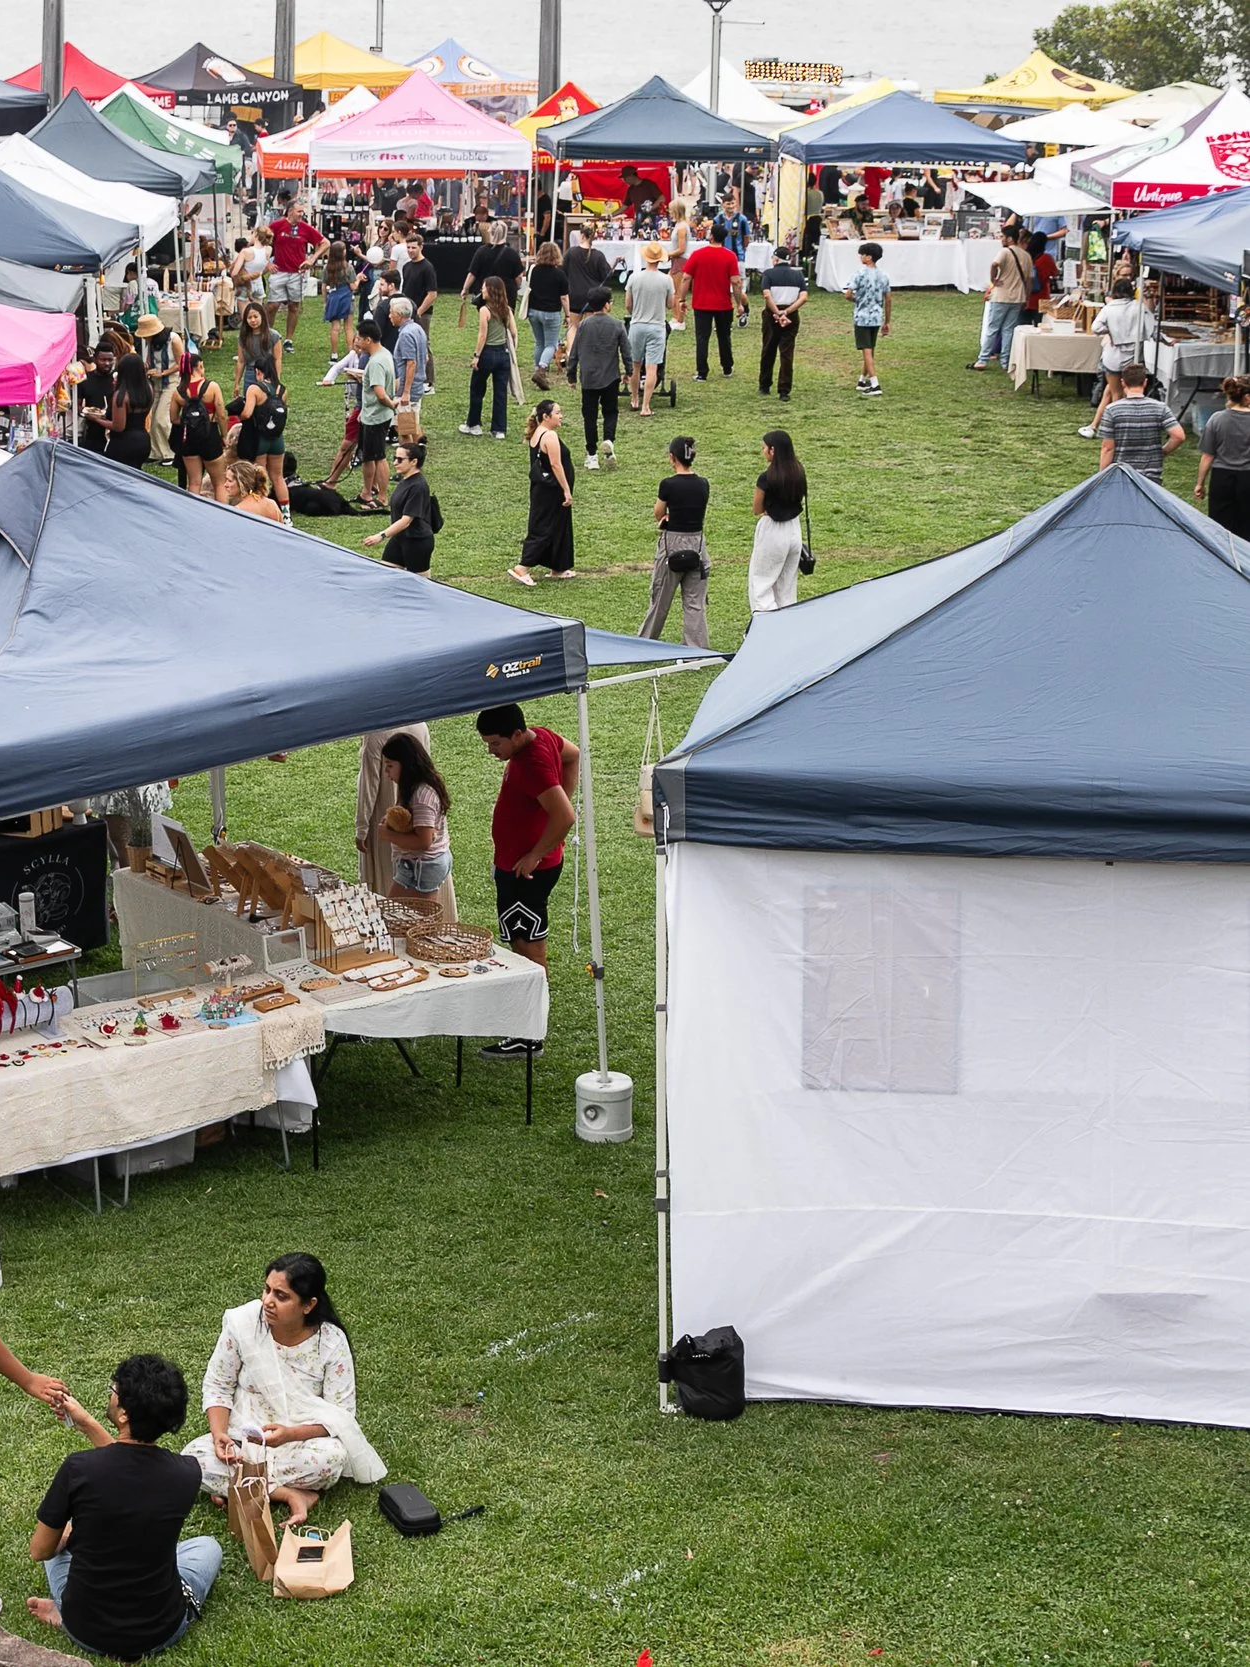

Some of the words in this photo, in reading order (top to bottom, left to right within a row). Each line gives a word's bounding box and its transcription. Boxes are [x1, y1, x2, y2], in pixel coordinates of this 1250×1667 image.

[207, 92, 239, 105] LAMB
[241, 90, 290, 104] CANYON
[350, 151, 377, 162] Life's
[379, 152, 405, 161] flat
[407, 151, 447, 161] without
[449, 150, 488, 162] bubbles
[1133, 185, 1184, 207] Unique
[501, 656, 542, 673] OZtrail
[23, 854, 70, 876] SCYLLA
